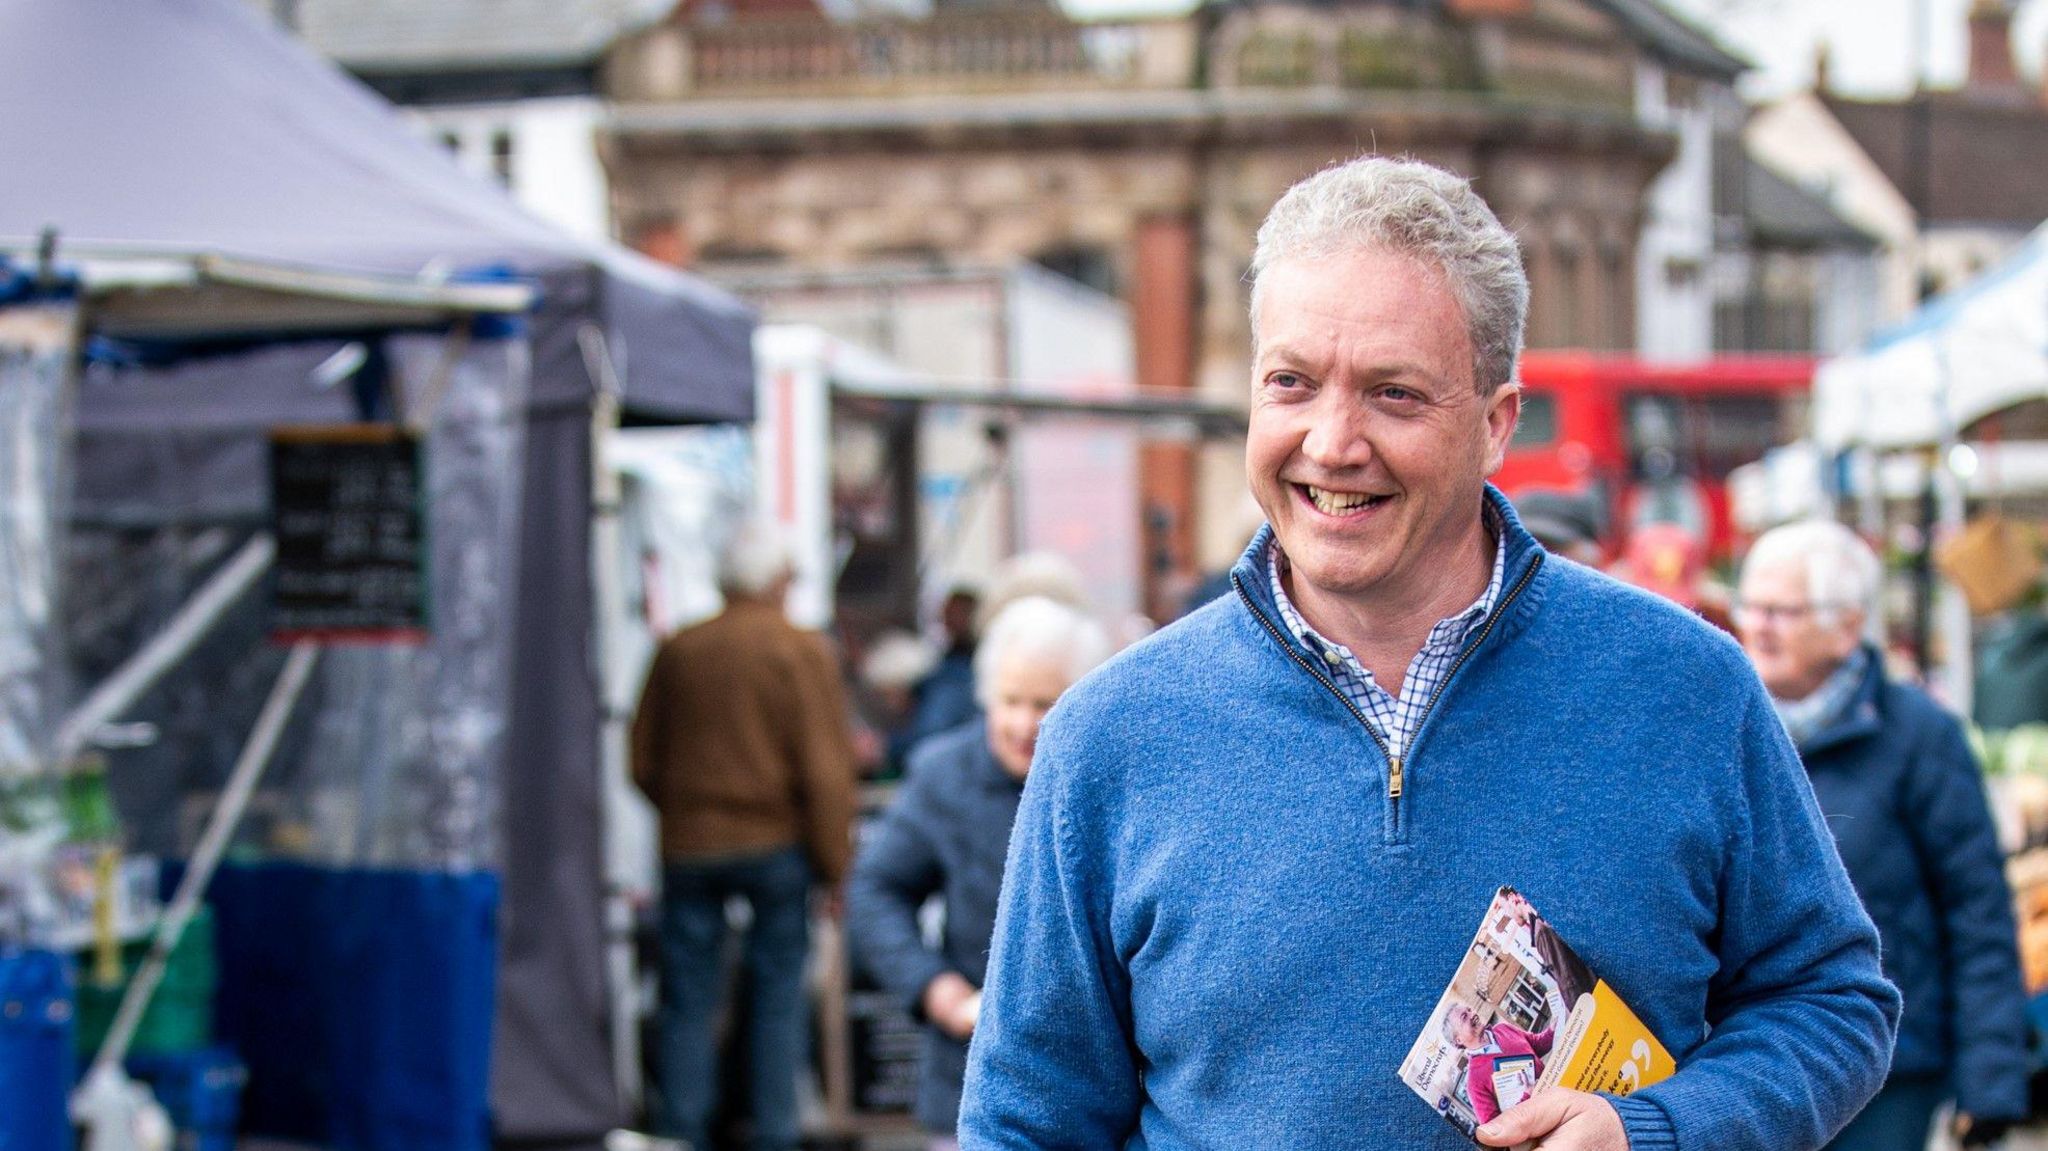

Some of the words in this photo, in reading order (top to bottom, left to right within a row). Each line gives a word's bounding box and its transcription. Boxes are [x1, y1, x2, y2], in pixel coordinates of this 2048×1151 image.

[1555, 1037, 1567, 1058] Liberal
[1565, 1007, 1582, 1038] Democrat
[1588, 1028, 1610, 1066] everybody
[1415, 1056, 1431, 1086] Liberal
[1421, 1046, 1446, 1091] Democrats
[1585, 1073, 1594, 1090] and
[1592, 1063, 1601, 1075] the
[1599, 1038, 1614, 1063] energy
[1618, 1069, 1623, 1079] a
